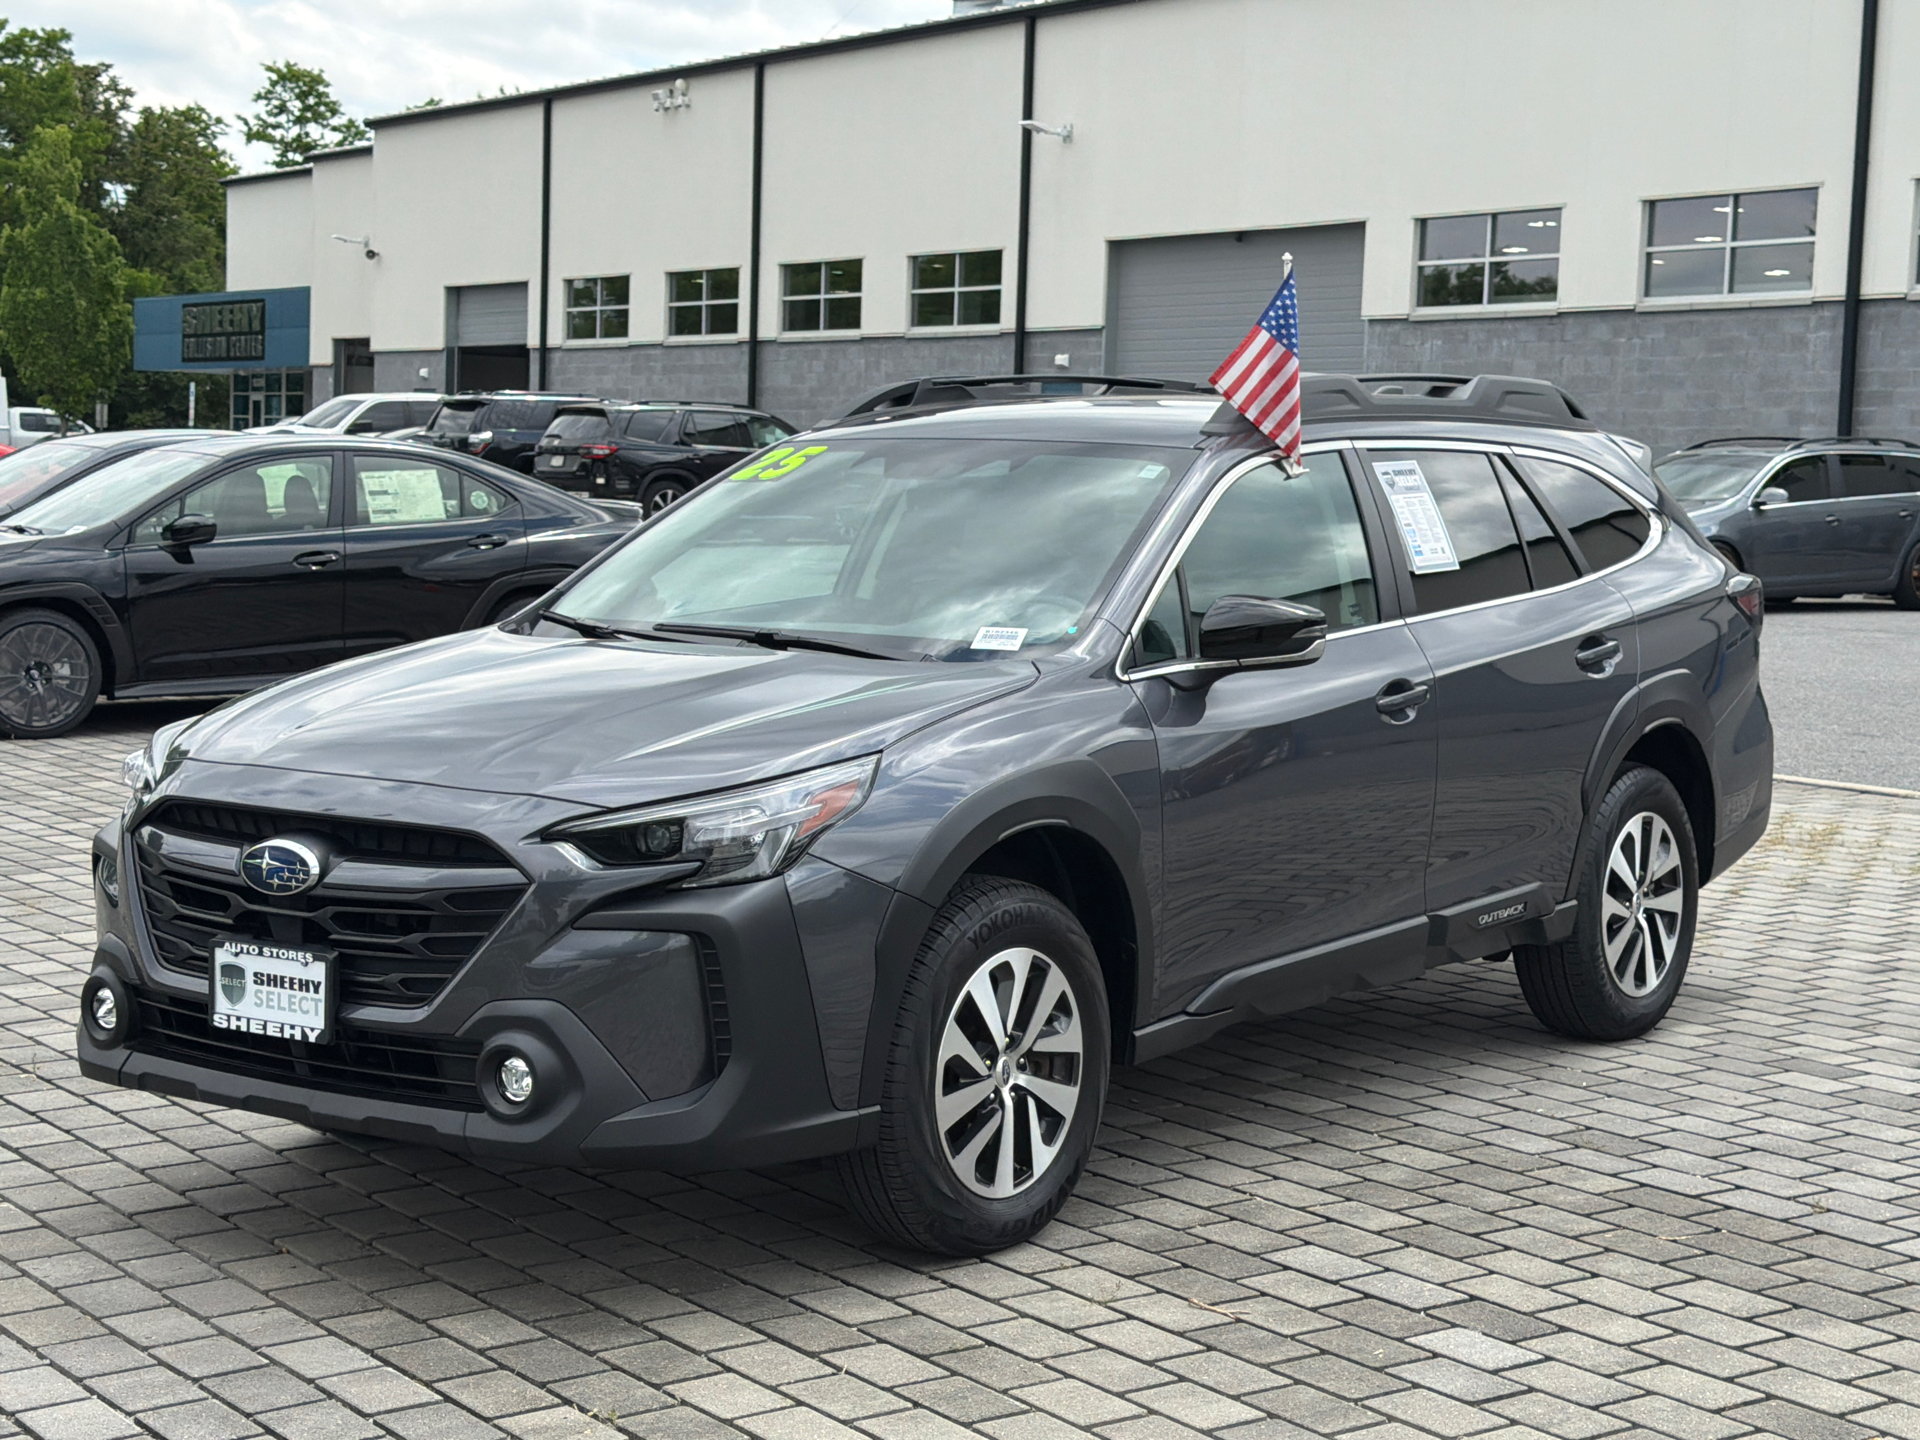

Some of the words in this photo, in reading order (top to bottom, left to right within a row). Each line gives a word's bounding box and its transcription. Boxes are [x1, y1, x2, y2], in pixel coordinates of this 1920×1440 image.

[182, 302, 264, 334] SHEEHY
[729, 446, 829, 480] 25
[1478, 903, 1525, 925] OUTBACK
[222, 942, 259, 956] AUTO
[262, 946, 314, 963] STORES
[220, 977, 246, 988] SELECT
[252, 971, 322, 995] SHEEHY
[253, 988, 323, 1017] SELECT
[212, 1013, 322, 1043] SHEEHY
